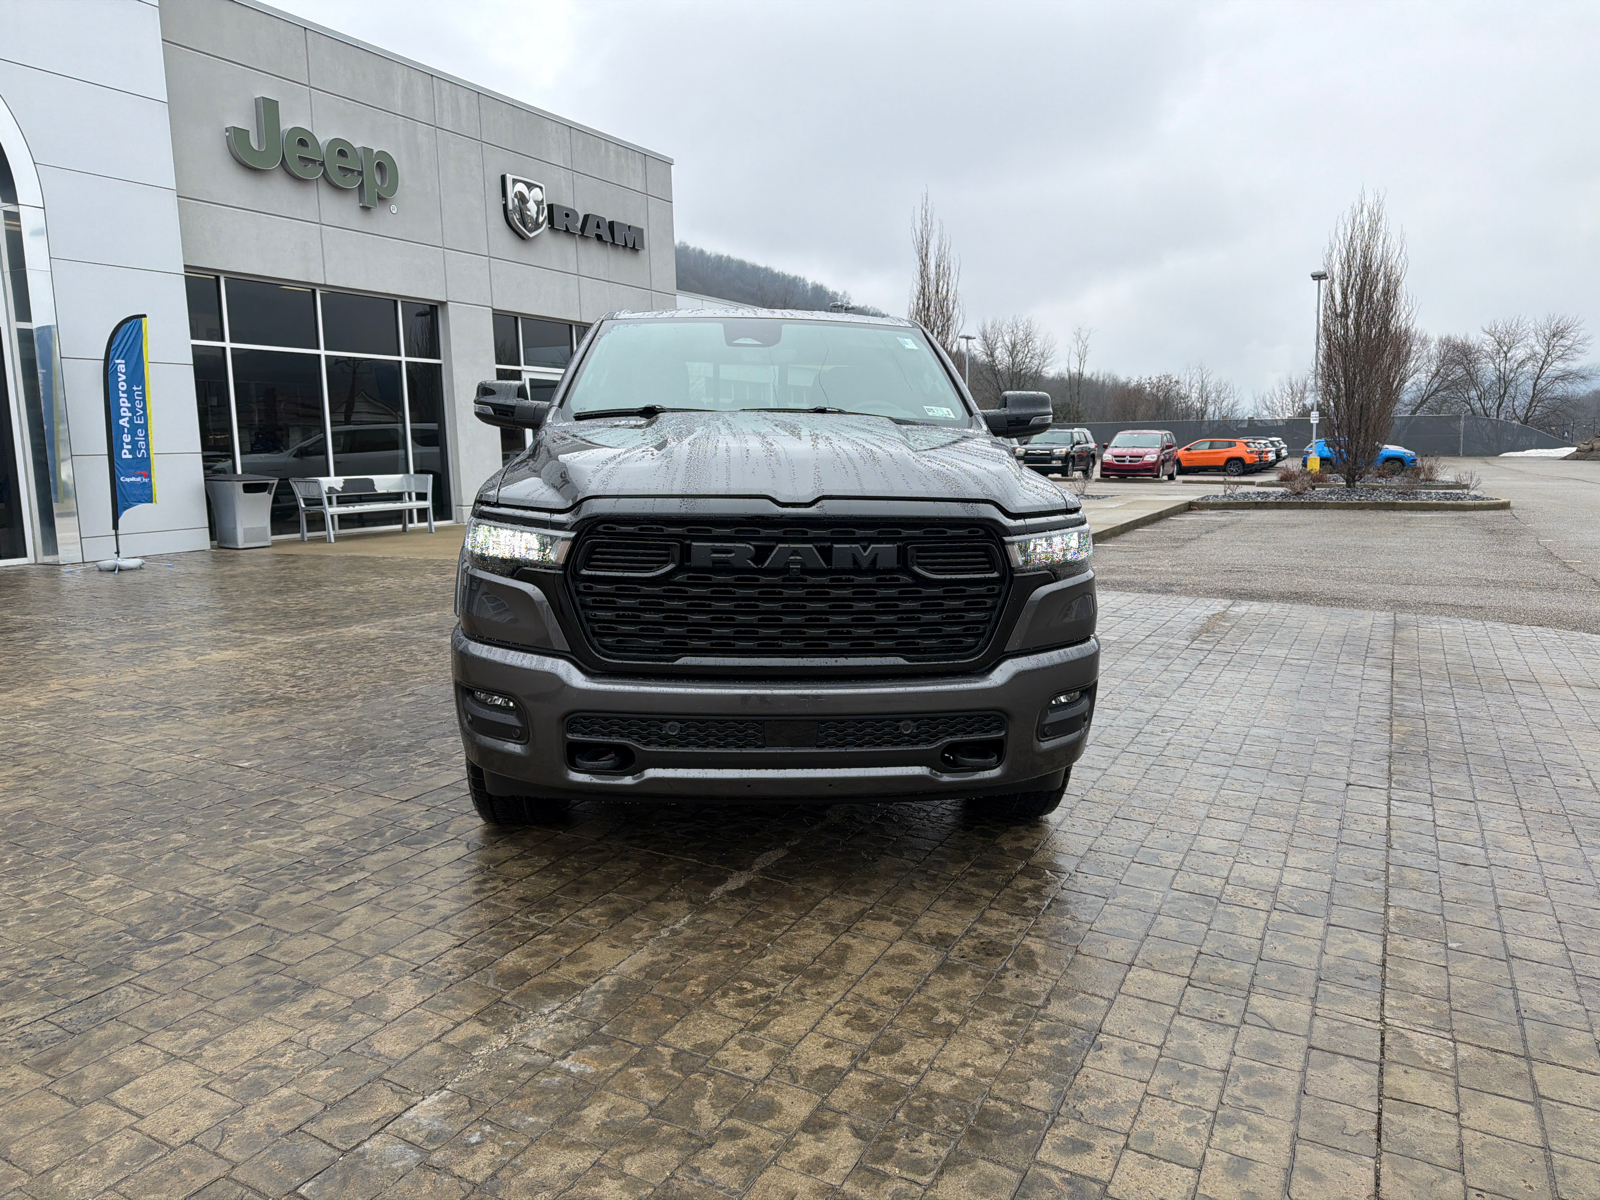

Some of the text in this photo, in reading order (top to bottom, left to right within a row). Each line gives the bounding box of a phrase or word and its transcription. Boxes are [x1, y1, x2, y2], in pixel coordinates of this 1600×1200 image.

[225, 96, 399, 208] Jeep
[547, 203, 645, 250] RAM
[114, 359, 132, 459] Pre-Approval
[132, 385, 147, 458] Sale Event
[691, 542, 898, 569] RAM
